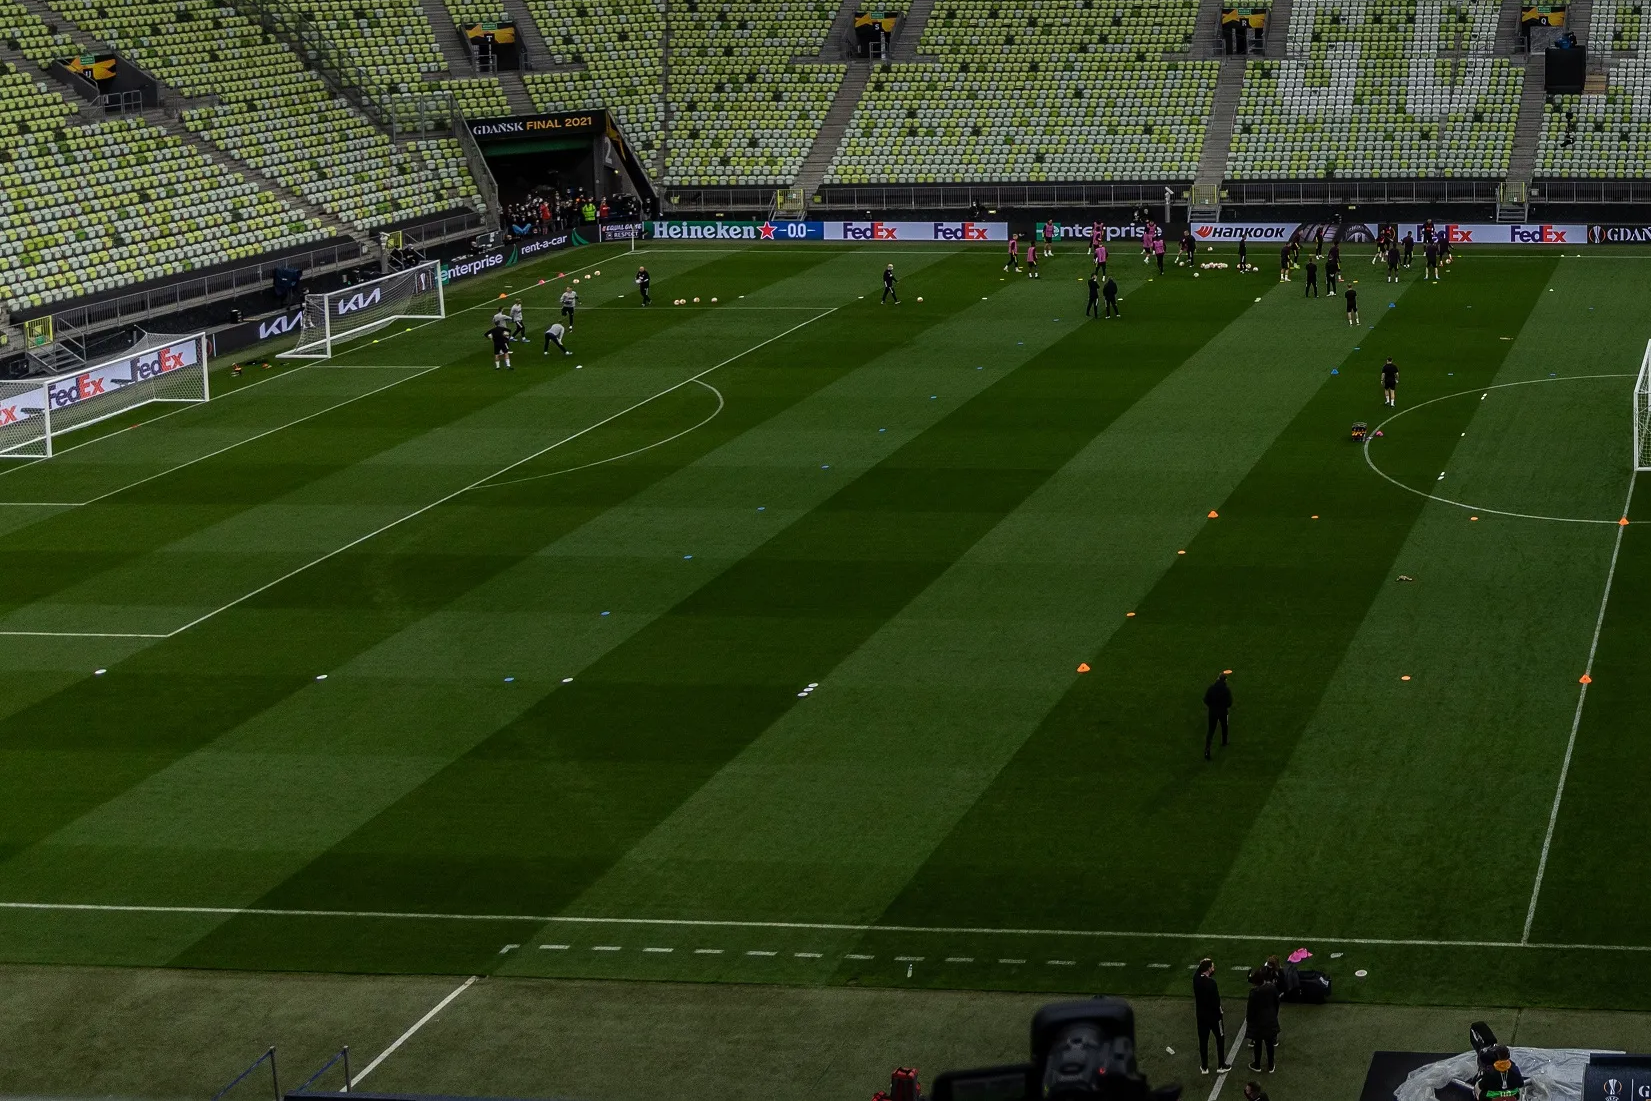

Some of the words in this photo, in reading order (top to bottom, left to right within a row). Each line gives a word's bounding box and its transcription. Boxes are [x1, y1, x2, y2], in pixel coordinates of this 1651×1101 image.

[1541, 18, 1547, 26] Q
[473, 121, 524, 136] GDAŃSK
[526, 119, 562, 131] FINAL
[564, 116, 592, 129] 2021
[605, 136, 613, 164] 2
[653, 221, 756, 240] Heineken
[843, 222, 898, 240] FedEx
[934, 222, 988, 240] FedEx
[1511, 225, 1567, 243] FedEx
[440, 254, 503, 282] enterprise
[521, 234, 568, 256] rent-a-car
[131, 347, 185, 382] FedEx
[48, 373, 105, 409] FedEx
